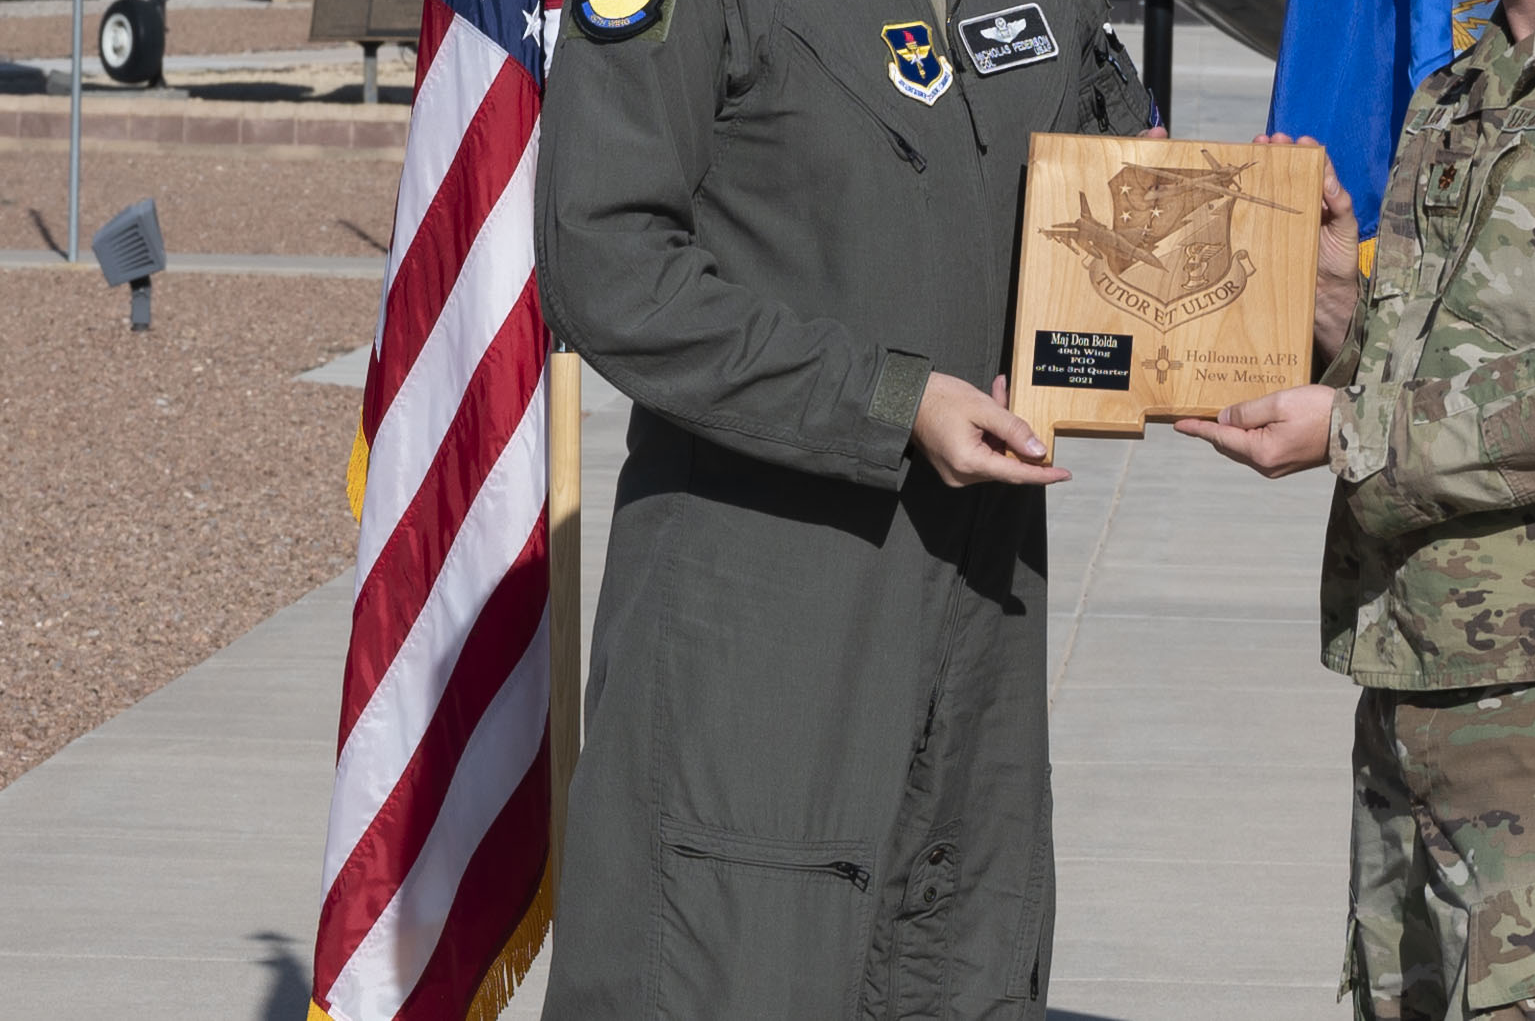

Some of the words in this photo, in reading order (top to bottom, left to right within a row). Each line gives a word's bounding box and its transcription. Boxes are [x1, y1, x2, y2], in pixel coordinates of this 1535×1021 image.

[975, 44, 1012, 62] NICHOLAS
[1096, 272, 1151, 316] TUTOR
[1154, 307, 1177, 326] ET
[1181, 280, 1240, 316] ULTOR
[1050, 332, 1070, 347] Maj
[1071, 333, 1090, 346] Don
[1092, 334, 1118, 348] Bolda
[1057, 347, 1081, 355] 49th
[1084, 348, 1111, 358] Wing
[1070, 356, 1095, 365] FGO
[1186, 349, 1259, 365] Holloman
[1263, 353, 1298, 366] AFB
[1047, 364, 1065, 373] the
[1067, 365, 1085, 374] 3rd
[1087, 366, 1129, 376] Quarter
[1195, 368, 1229, 382] New
[1233, 369, 1286, 384] Mexico
[1068, 376, 1093, 384] 2021
